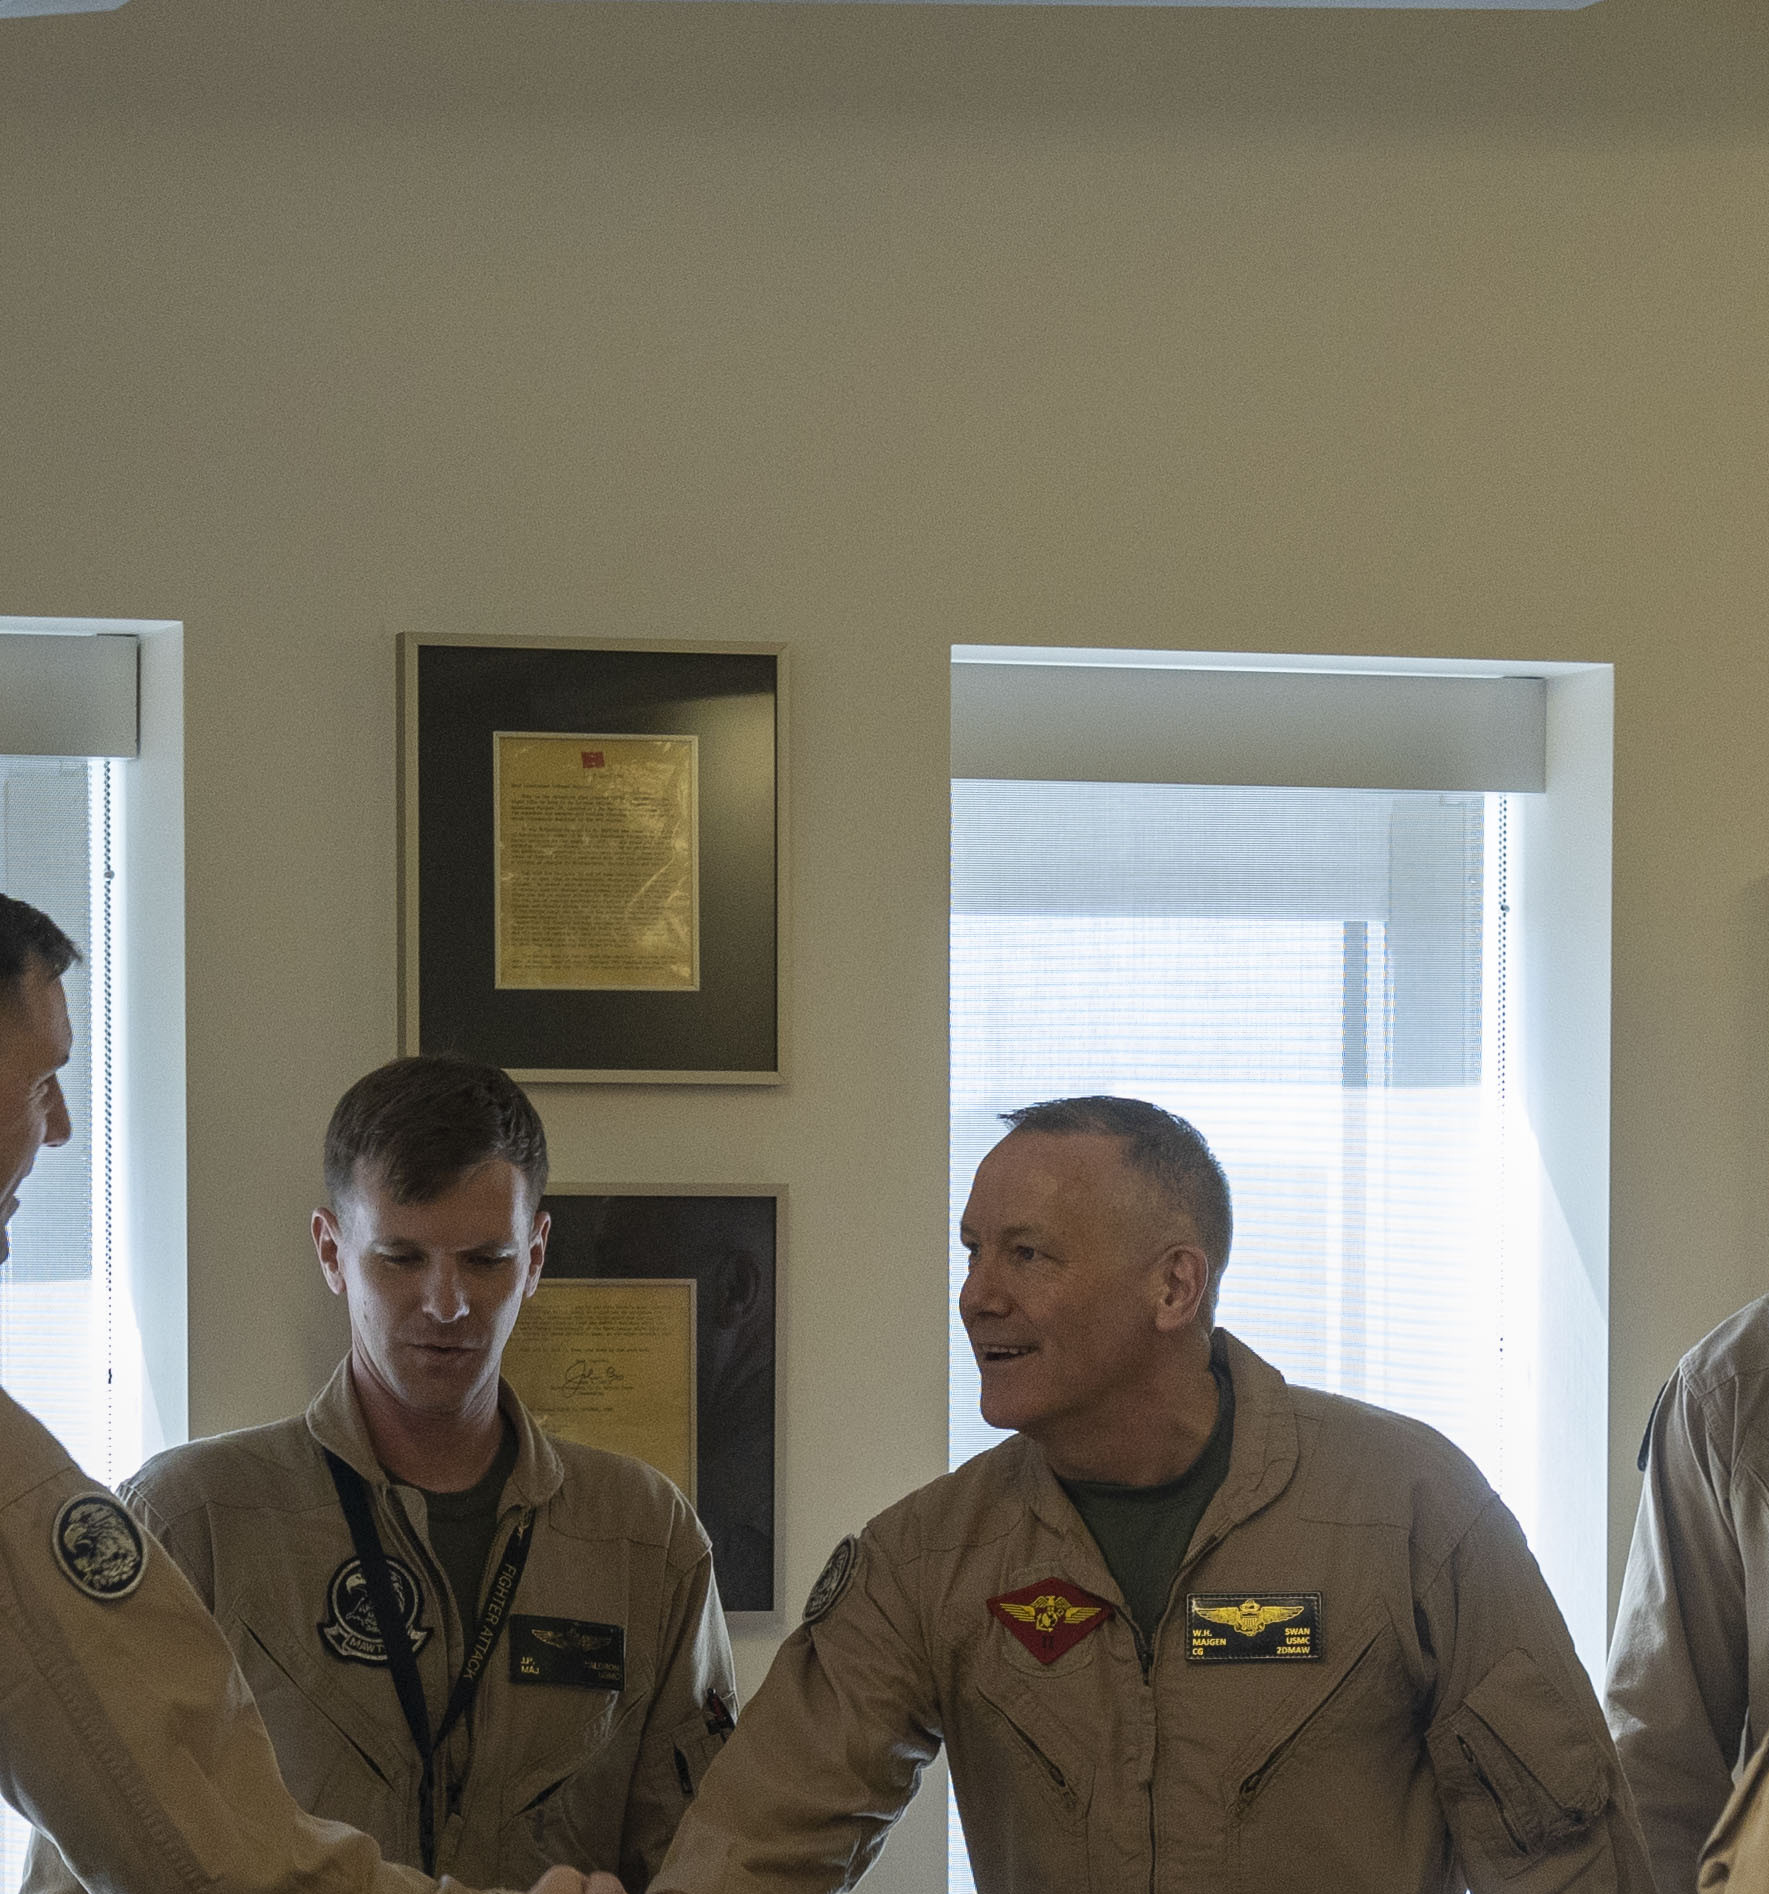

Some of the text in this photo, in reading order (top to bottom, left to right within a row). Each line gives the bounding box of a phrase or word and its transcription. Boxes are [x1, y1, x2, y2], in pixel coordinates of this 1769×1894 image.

[463, 1563, 517, 1680] FIGHTER ATTACK
[1284, 1628, 1311, 1636] SWAN
[1286, 1636, 1311, 1645] USMC
[1192, 1646, 1311, 1656] CG 2DMAW
[521, 1665, 540, 1675] MAJ
